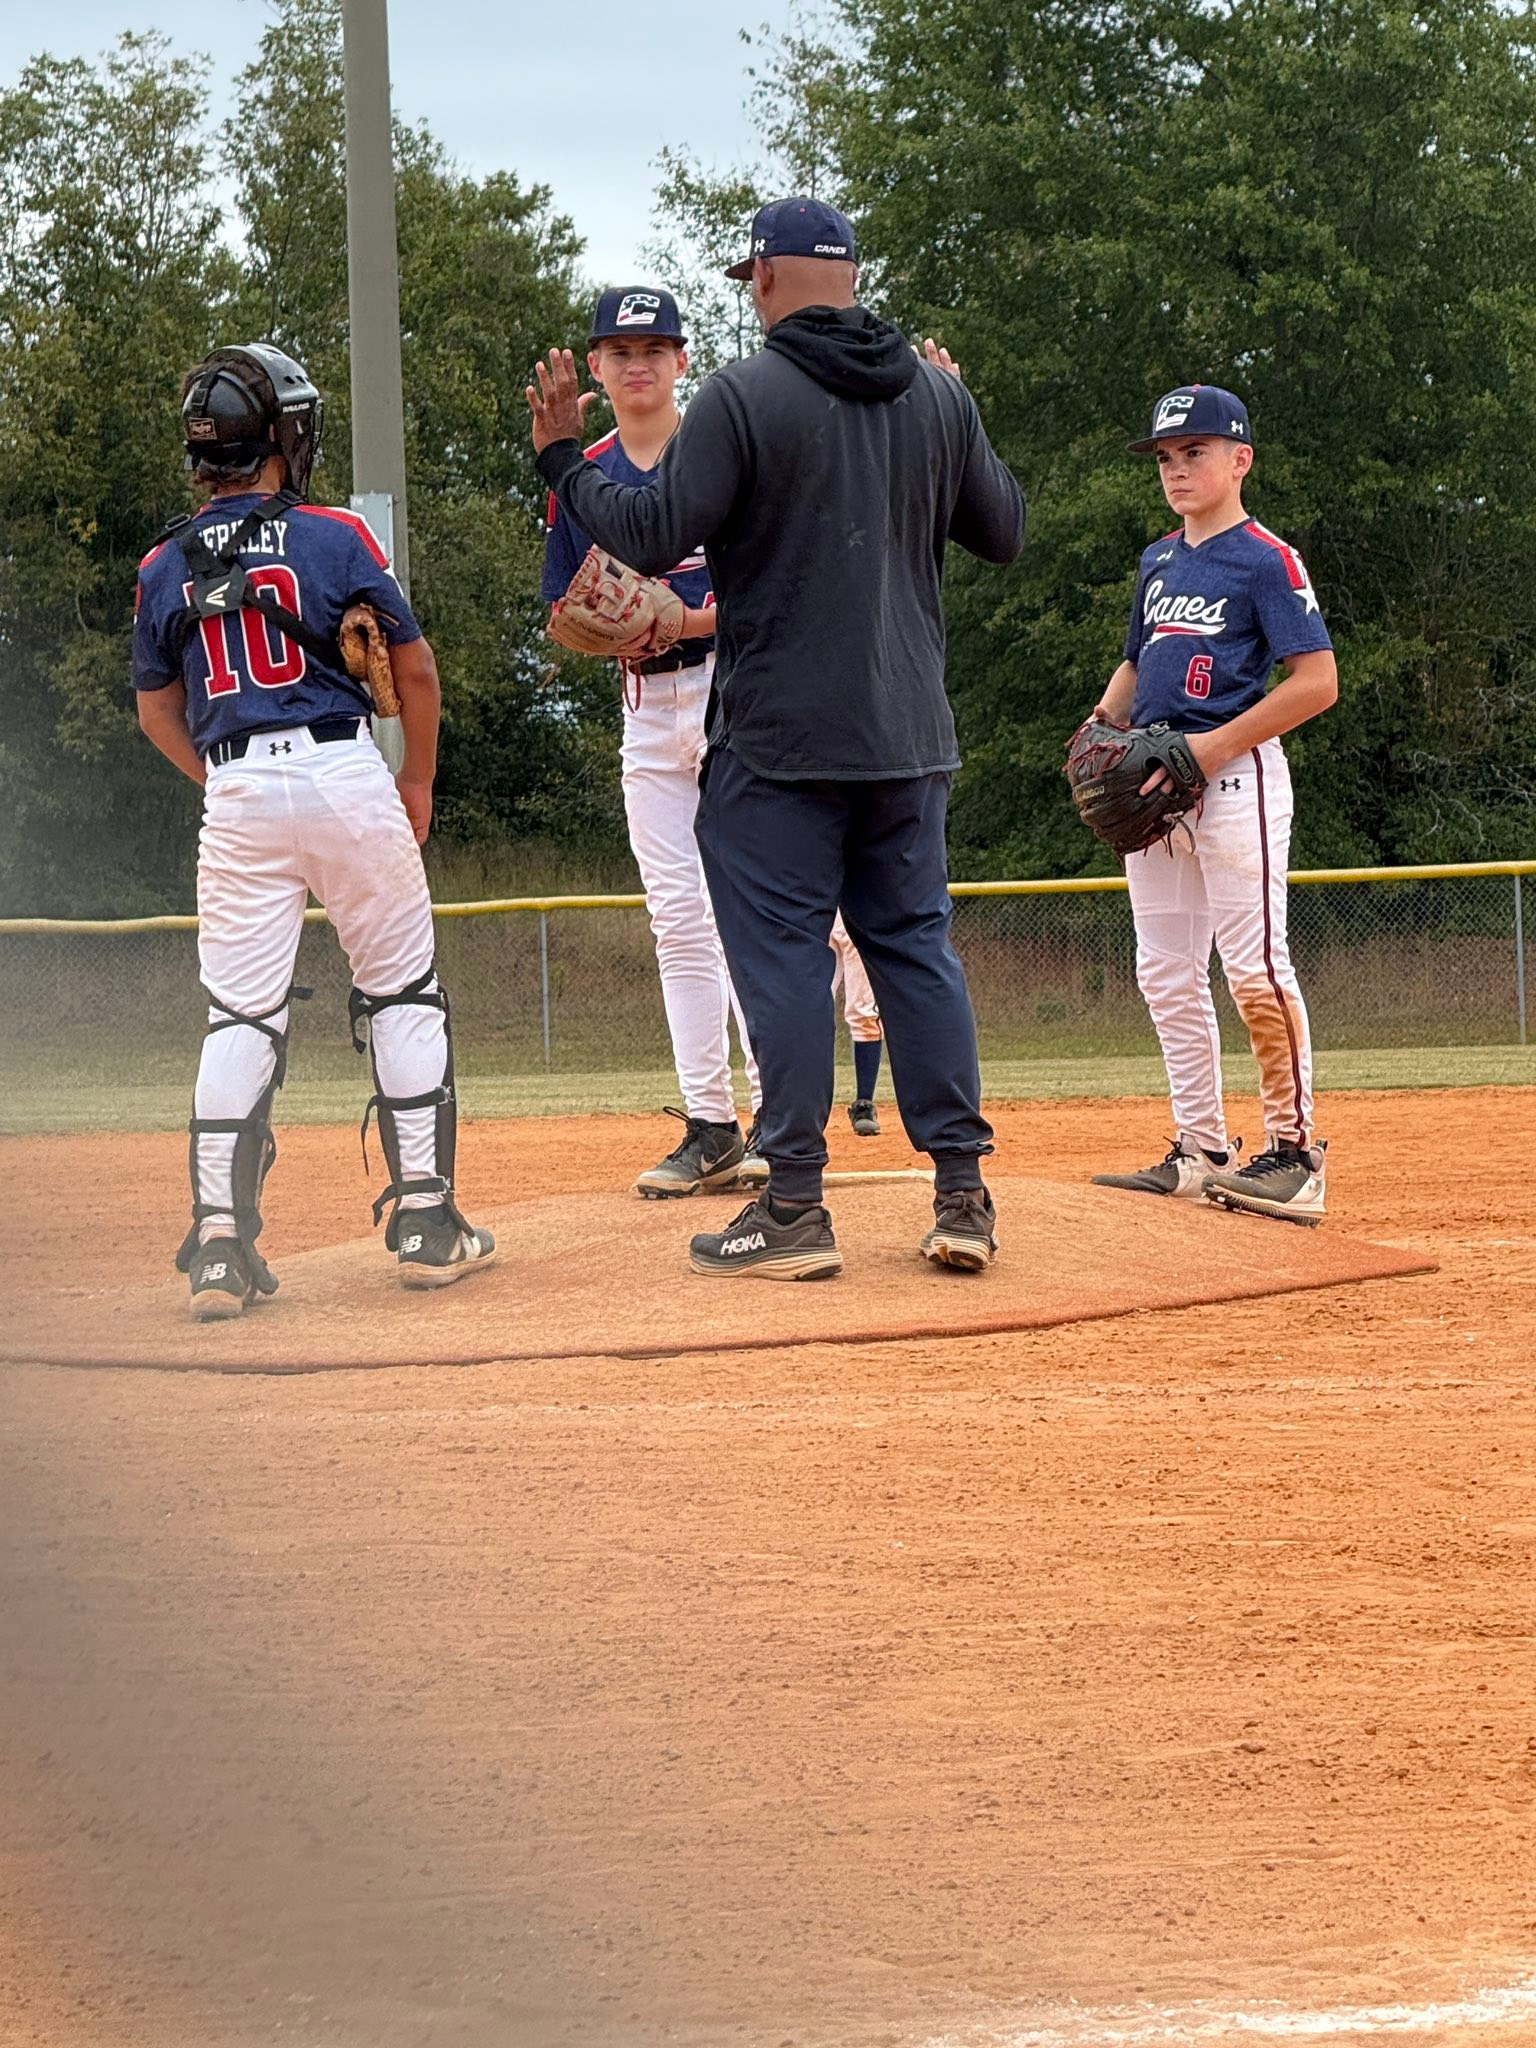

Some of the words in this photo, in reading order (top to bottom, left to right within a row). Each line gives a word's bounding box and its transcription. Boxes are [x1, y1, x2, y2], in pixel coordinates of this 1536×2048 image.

[616, 293, 661, 326] C
[1155, 395, 1195, 431] C
[1143, 579, 1228, 625] Canes
[183, 564, 306, 700] 10
[1185, 655, 1213, 700] 6
[720, 1231, 767, 1256] HOKA
